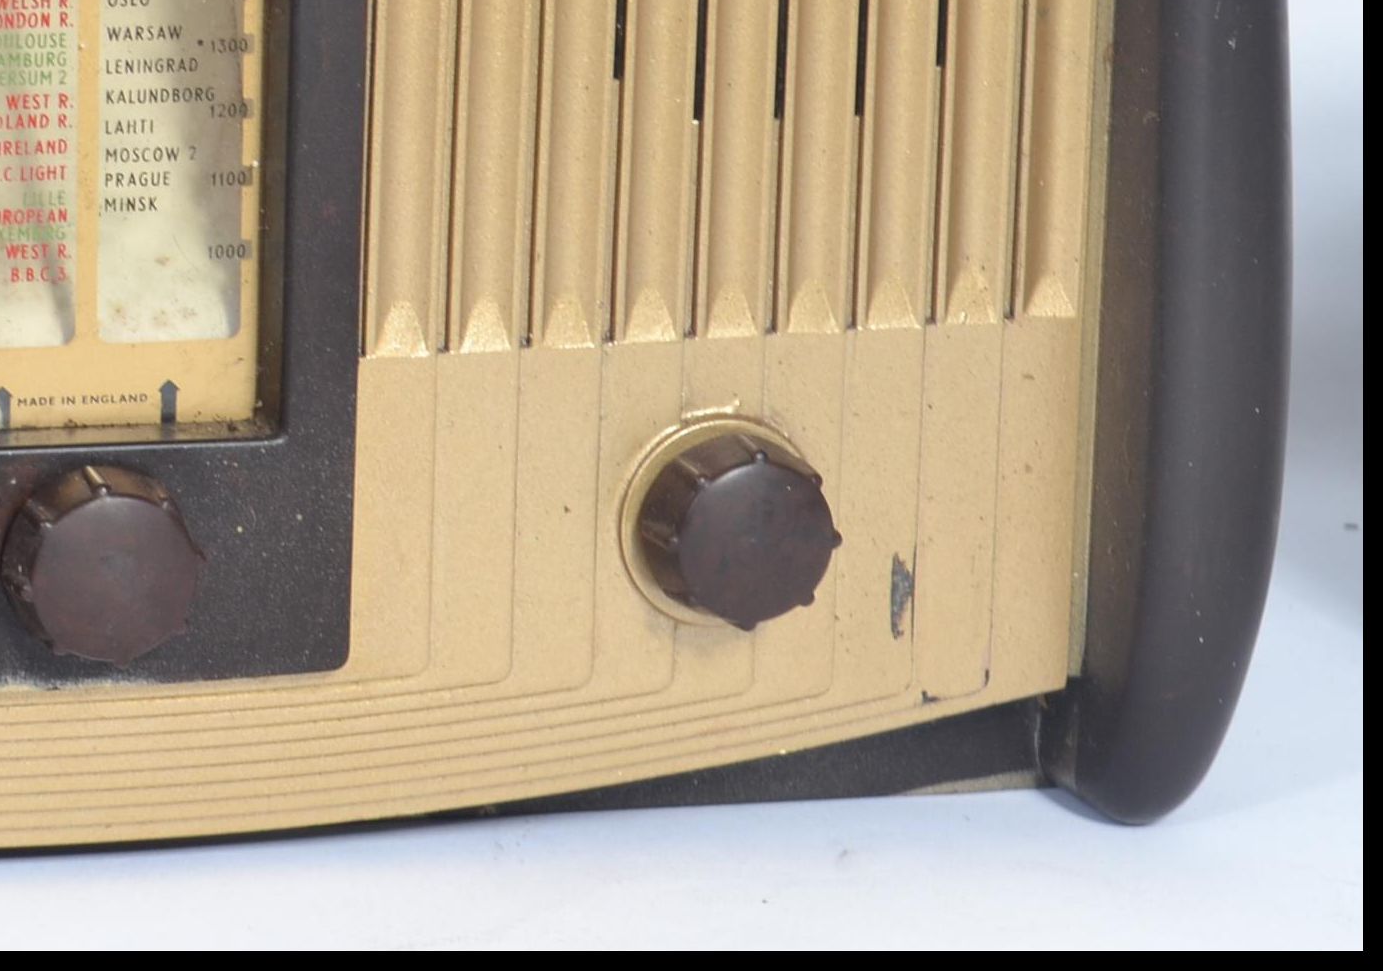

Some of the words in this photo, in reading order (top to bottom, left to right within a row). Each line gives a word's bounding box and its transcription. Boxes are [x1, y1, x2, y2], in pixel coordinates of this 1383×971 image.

[106, 25, 183, 42] WARSAW
[212, 38, 249, 54] 1300
[106, 57, 199, 75] LENINGRAD
[58, 69, 67, 85] 2
[6, 93, 51, 110] WEST
[105, 87, 215, 105] KALUNDBORG
[209, 103, 249, 119] 1200
[104, 118, 154, 135] LAHTI
[104, 147, 180, 164] MOSCOW
[188, 145, 197, 161] 2
[104, 172, 171, 188] PRAGUE
[211, 170, 247, 187] 1100
[104, 196, 158, 213] MINSK
[6, 244, 49, 260] WEST
[208, 244, 246, 260] 1000
[18, 396, 55, 407] MADE
[62, 395, 76, 405] IN
[82, 393, 148, 405] ENGLAND
